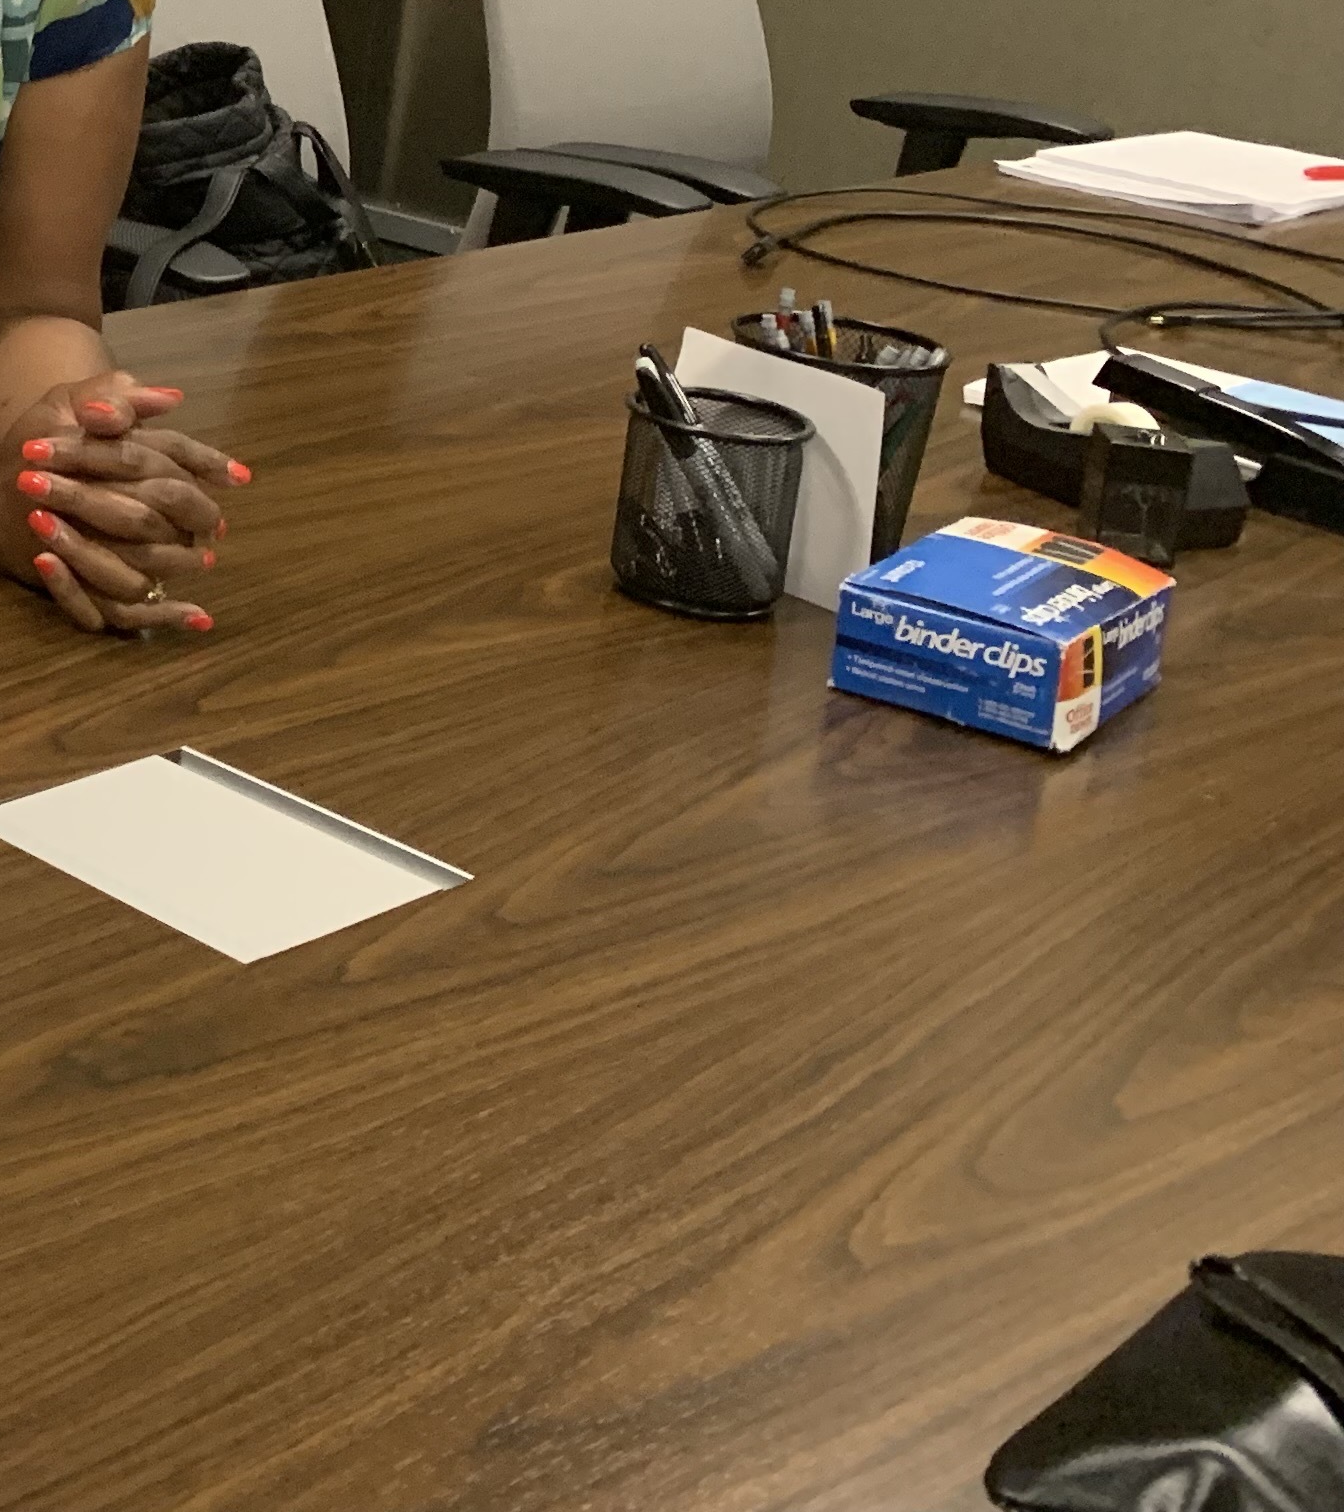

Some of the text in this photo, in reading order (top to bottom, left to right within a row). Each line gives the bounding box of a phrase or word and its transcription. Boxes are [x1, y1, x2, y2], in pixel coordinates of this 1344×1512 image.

[851, 601, 894, 626] Large
[894, 614, 986, 660] binder
[983, 640, 1048, 679] clips
